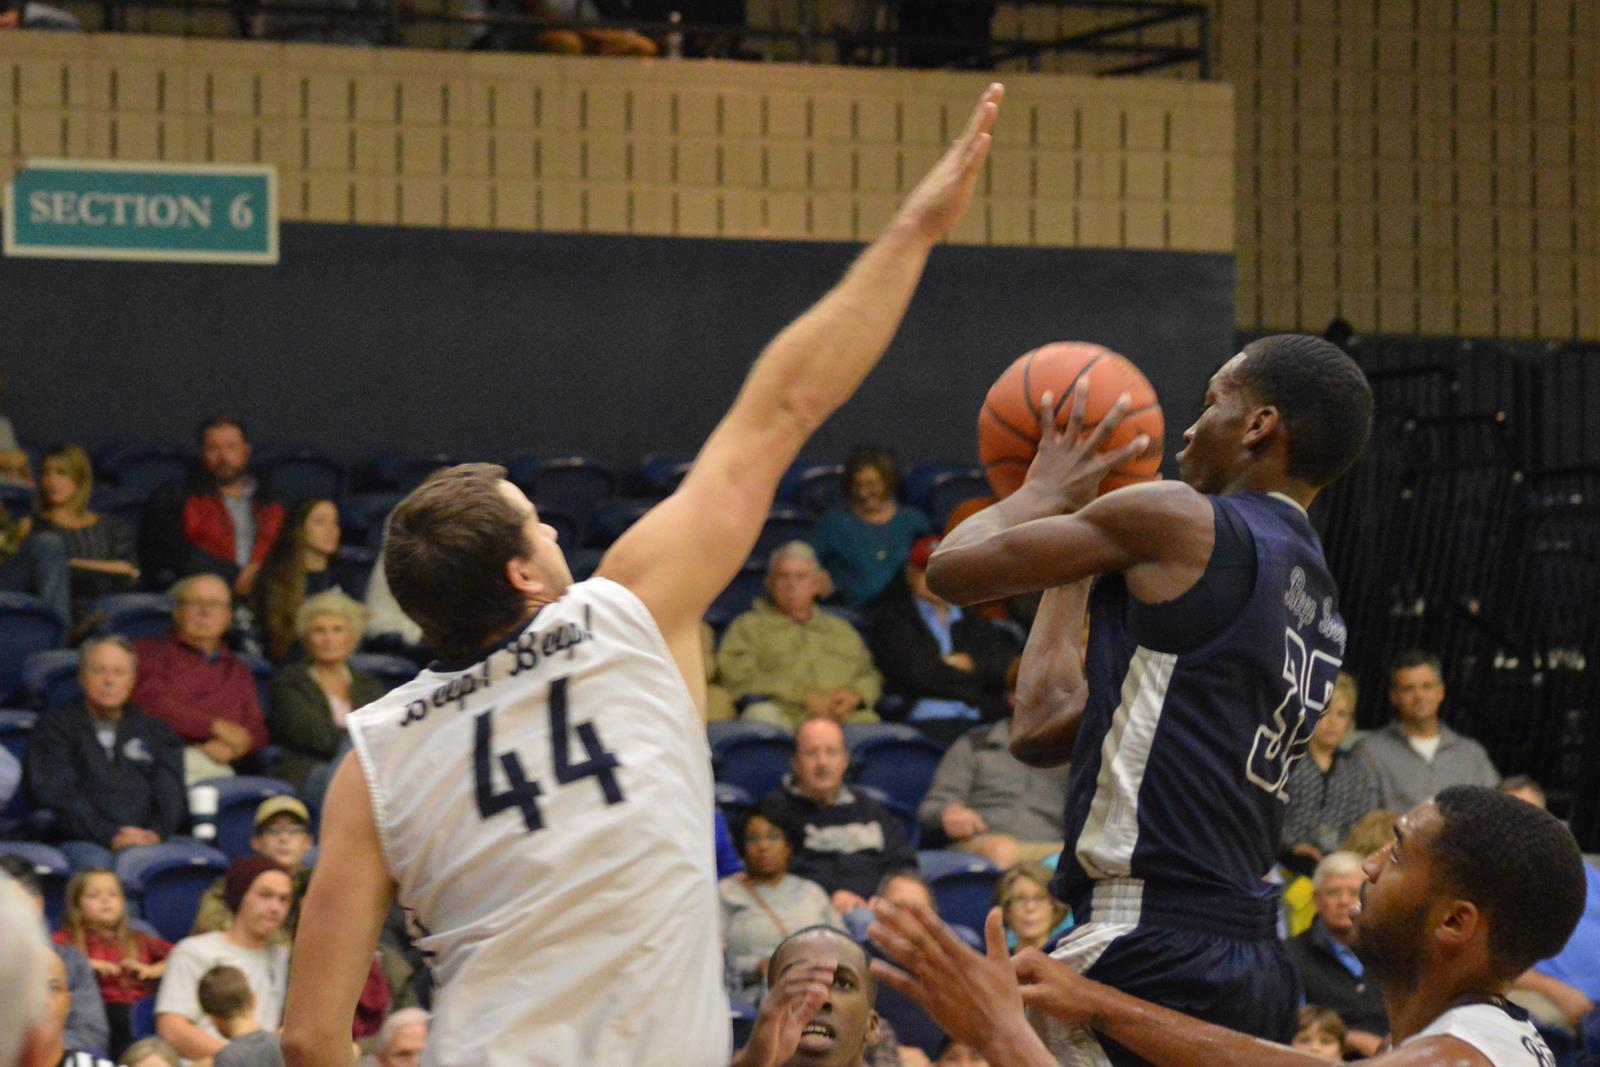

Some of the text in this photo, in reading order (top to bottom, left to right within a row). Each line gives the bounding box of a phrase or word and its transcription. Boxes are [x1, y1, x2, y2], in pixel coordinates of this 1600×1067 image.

[29, 190, 254, 230] SECTION 6
[473, 676, 626, 832] 44
